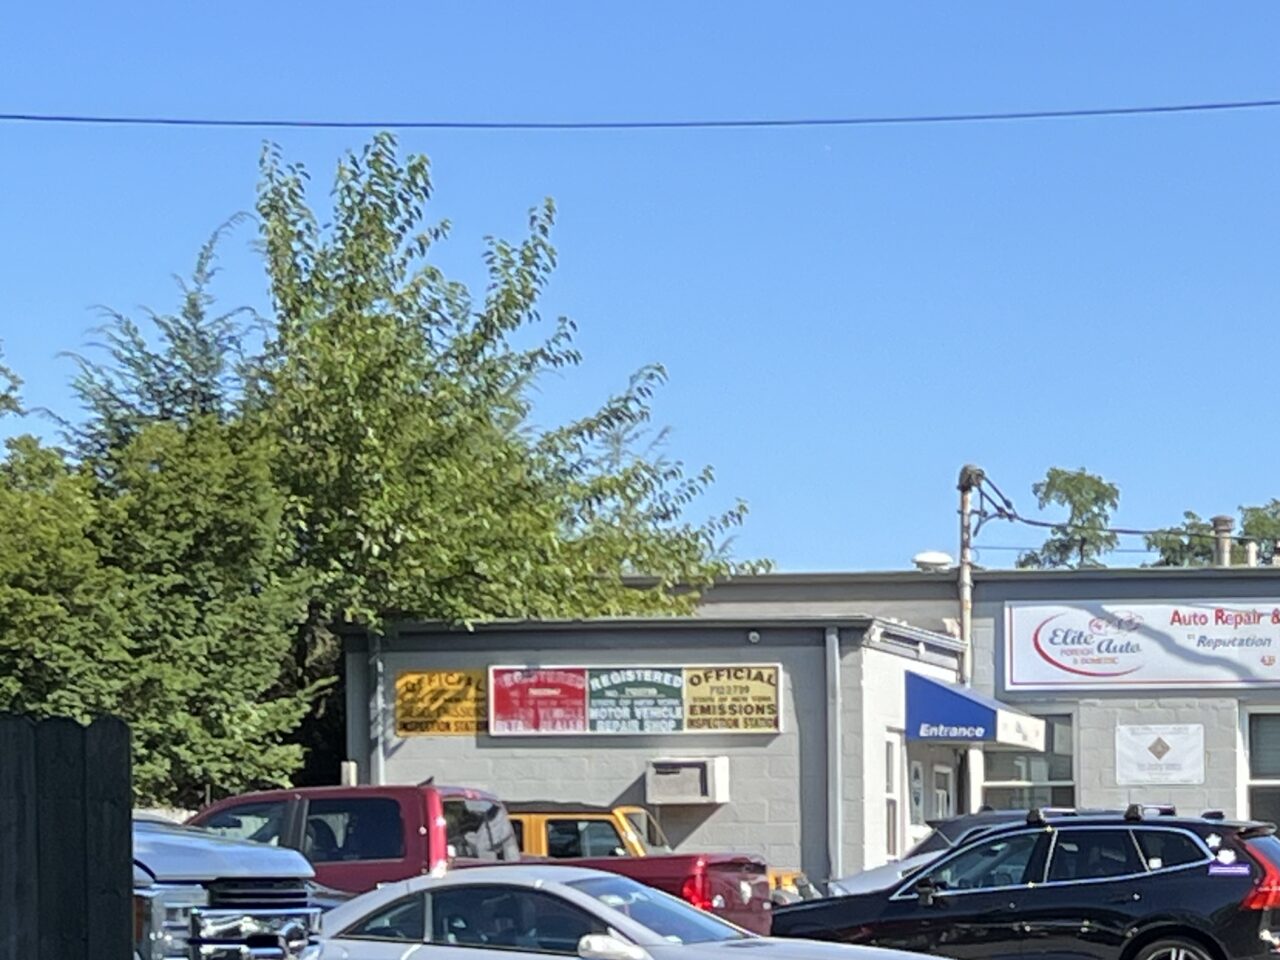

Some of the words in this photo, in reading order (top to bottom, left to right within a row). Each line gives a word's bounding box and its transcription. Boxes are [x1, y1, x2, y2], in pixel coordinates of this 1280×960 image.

[1170, 609, 1208, 626] Auto
[1214, 608, 1263, 629] Repair
[1048, 628, 1095, 646] Elite
[1096, 639, 1142, 654] Auto
[590, 670, 683, 691] REGISTERED
[689, 668, 776, 687] OFFICIAL
[589, 706, 630, 719] MOTOR
[634, 706, 683, 719] VEHICLE
[689, 704, 776, 716] EMISSIONS
[919, 723, 985, 737] Entrance
